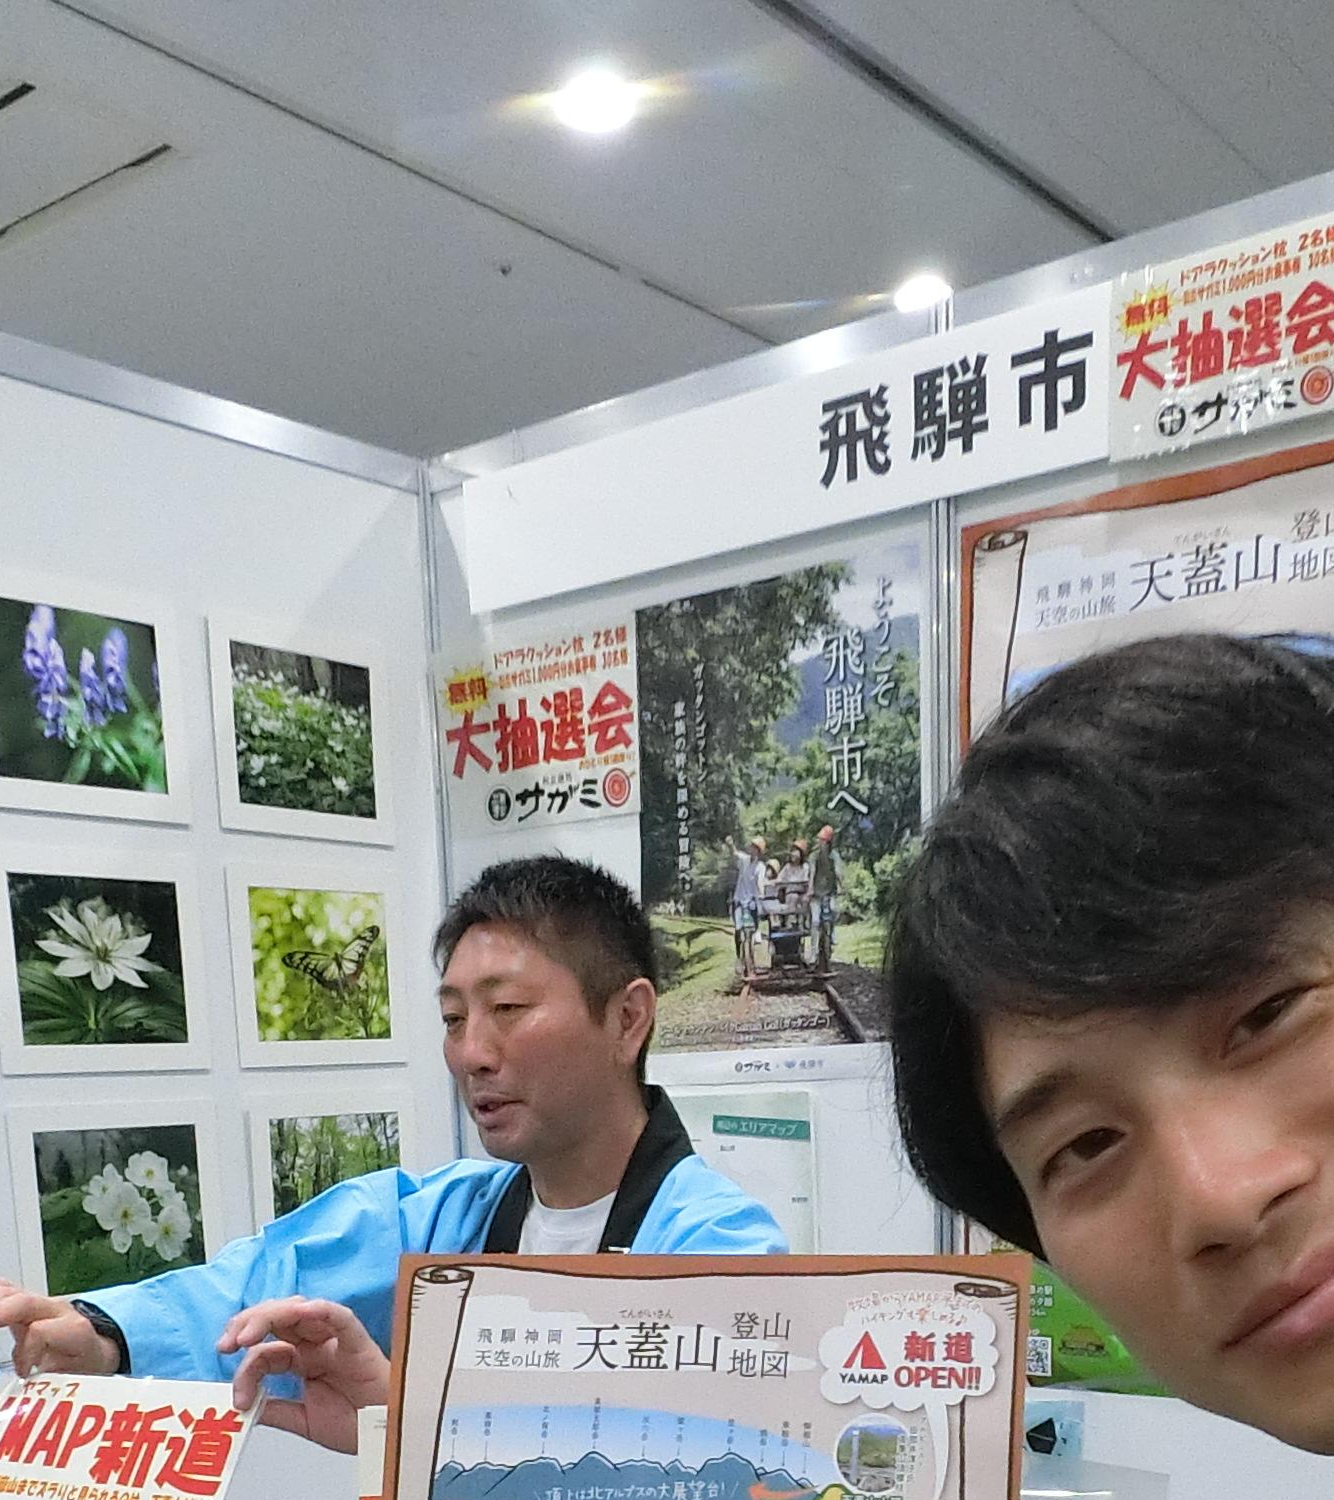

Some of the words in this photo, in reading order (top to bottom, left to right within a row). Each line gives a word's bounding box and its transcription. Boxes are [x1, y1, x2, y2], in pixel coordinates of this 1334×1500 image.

[818, 328, 1096, 490] 飛騨市
[1130, 534, 1281, 612] 天蓋山
[1035, 596, 1116, 628] 天空の山旅
[872, 576, 896, 707] ようこそ
[445, 680, 634, 779] 大抽選会
[823, 628, 869, 814] 飛騨市へ
[515, 779, 602, 823] サガミ
[477, 1327, 563, 1345] 飛騨神岡
[730, 1311, 792, 1341] 登山
[475, 1349, 562, 1369] 天空の山旅
[573, 1322, 722, 1373] 天蓋山
[726, 1348, 790, 1379] 地図
[903, 1330, 974, 1364] 新道
[22, 1380, 80, 1398] ヤマップ
[839, 1372, 889, 1385] YAMAP
[893, 1365, 982, 1391] OPEN!!
